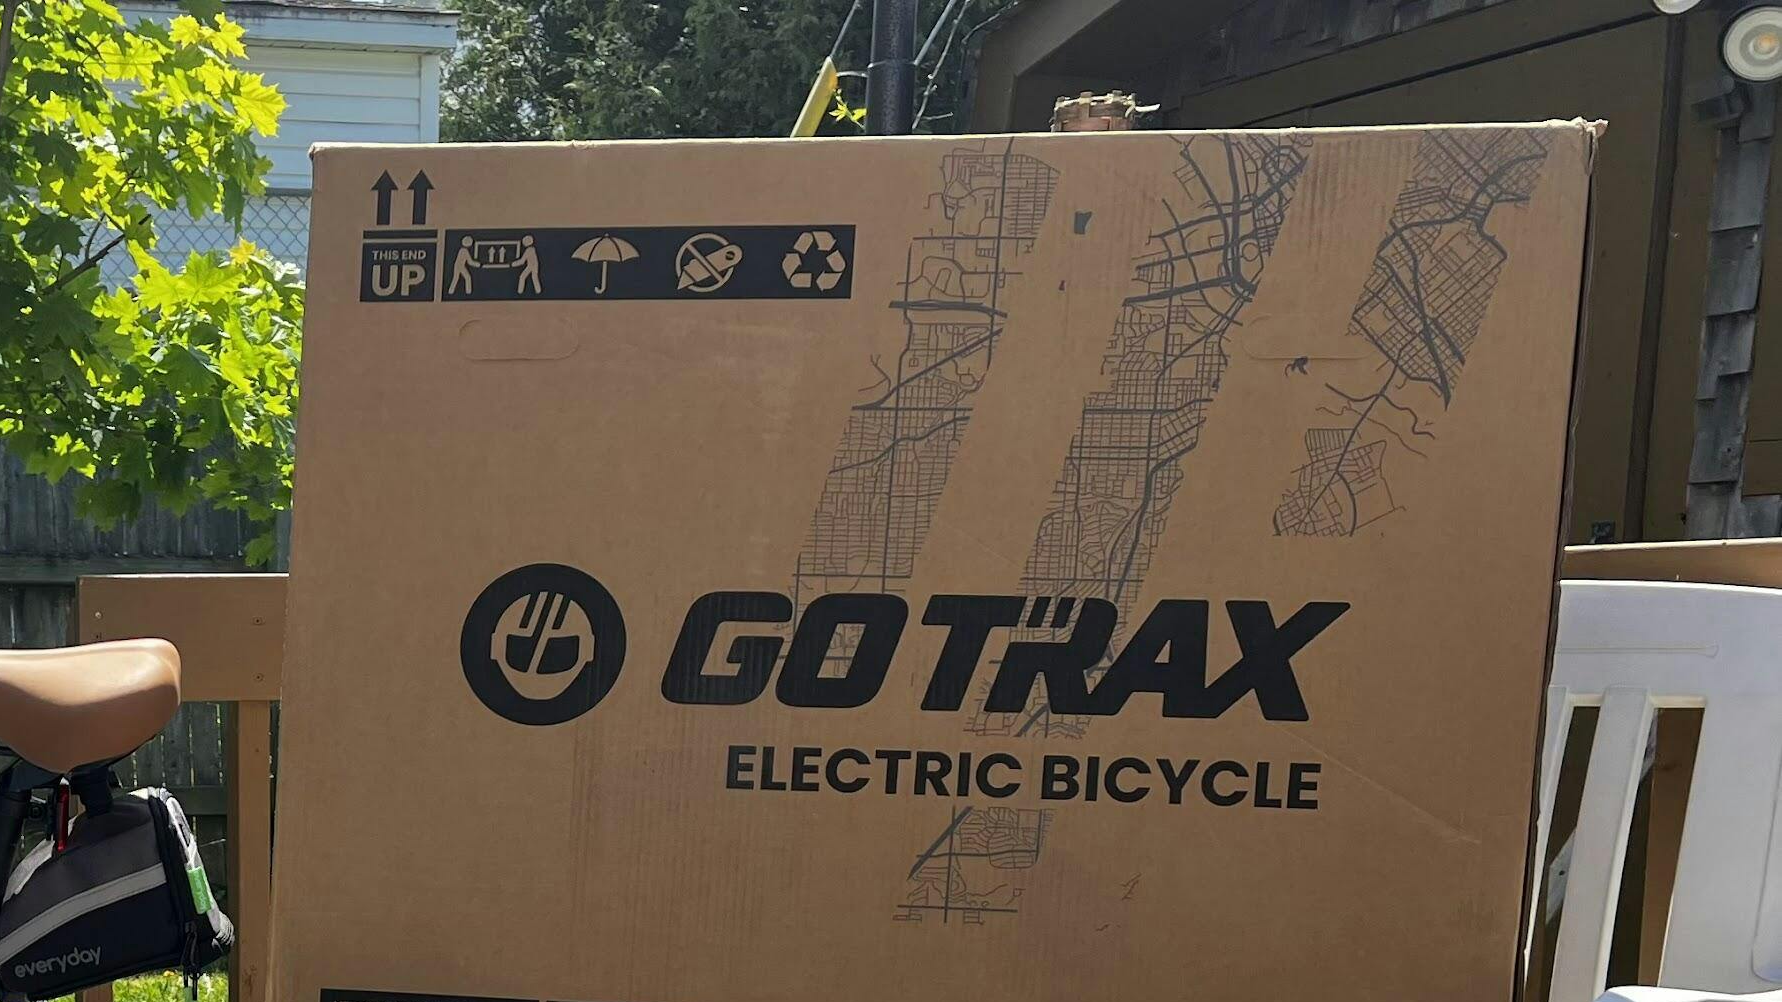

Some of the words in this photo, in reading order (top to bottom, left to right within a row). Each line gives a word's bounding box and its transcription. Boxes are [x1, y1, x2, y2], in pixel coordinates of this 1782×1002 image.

[371, 249, 399, 262] THIS
[400, 249, 427, 261] END
[371, 263, 426, 297] UP
[661, 591, 1351, 722] GOTRAX
[724, 744, 1022, 799] ELECTRIC
[1041, 755, 1323, 810] BICYCLE
[13, 945, 102, 979] everyday
